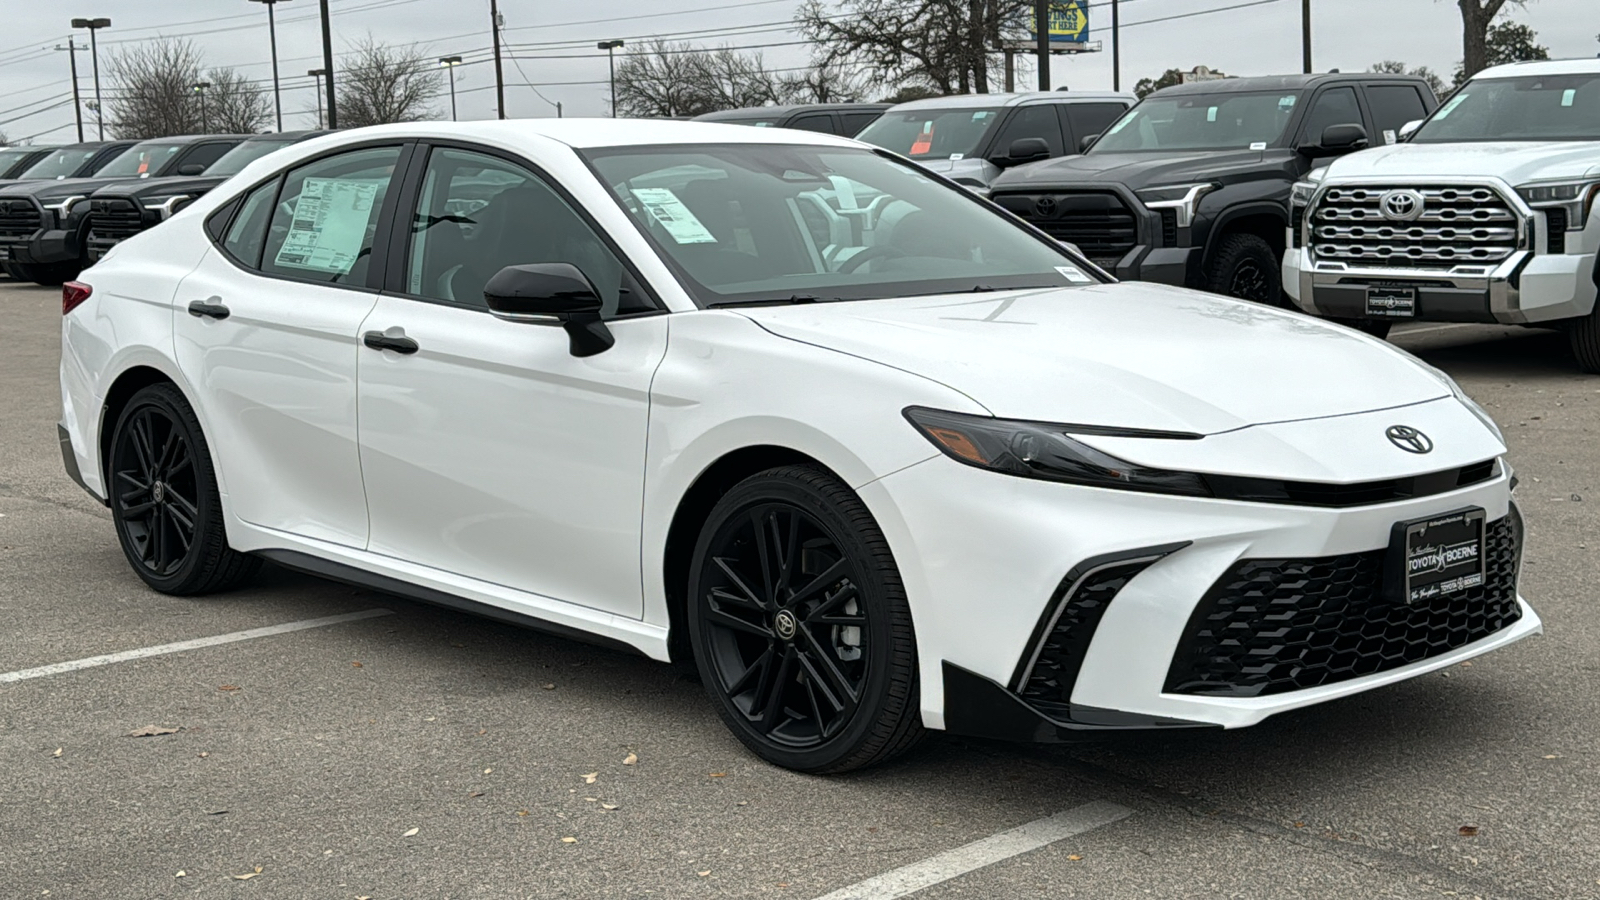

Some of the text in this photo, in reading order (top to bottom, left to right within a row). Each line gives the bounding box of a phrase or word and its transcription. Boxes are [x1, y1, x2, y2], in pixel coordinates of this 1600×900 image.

[1059, 21, 1078, 30] HERE
[1408, 554, 1437, 571] TOYOTA
[1446, 544, 1478, 562] BOERNE
